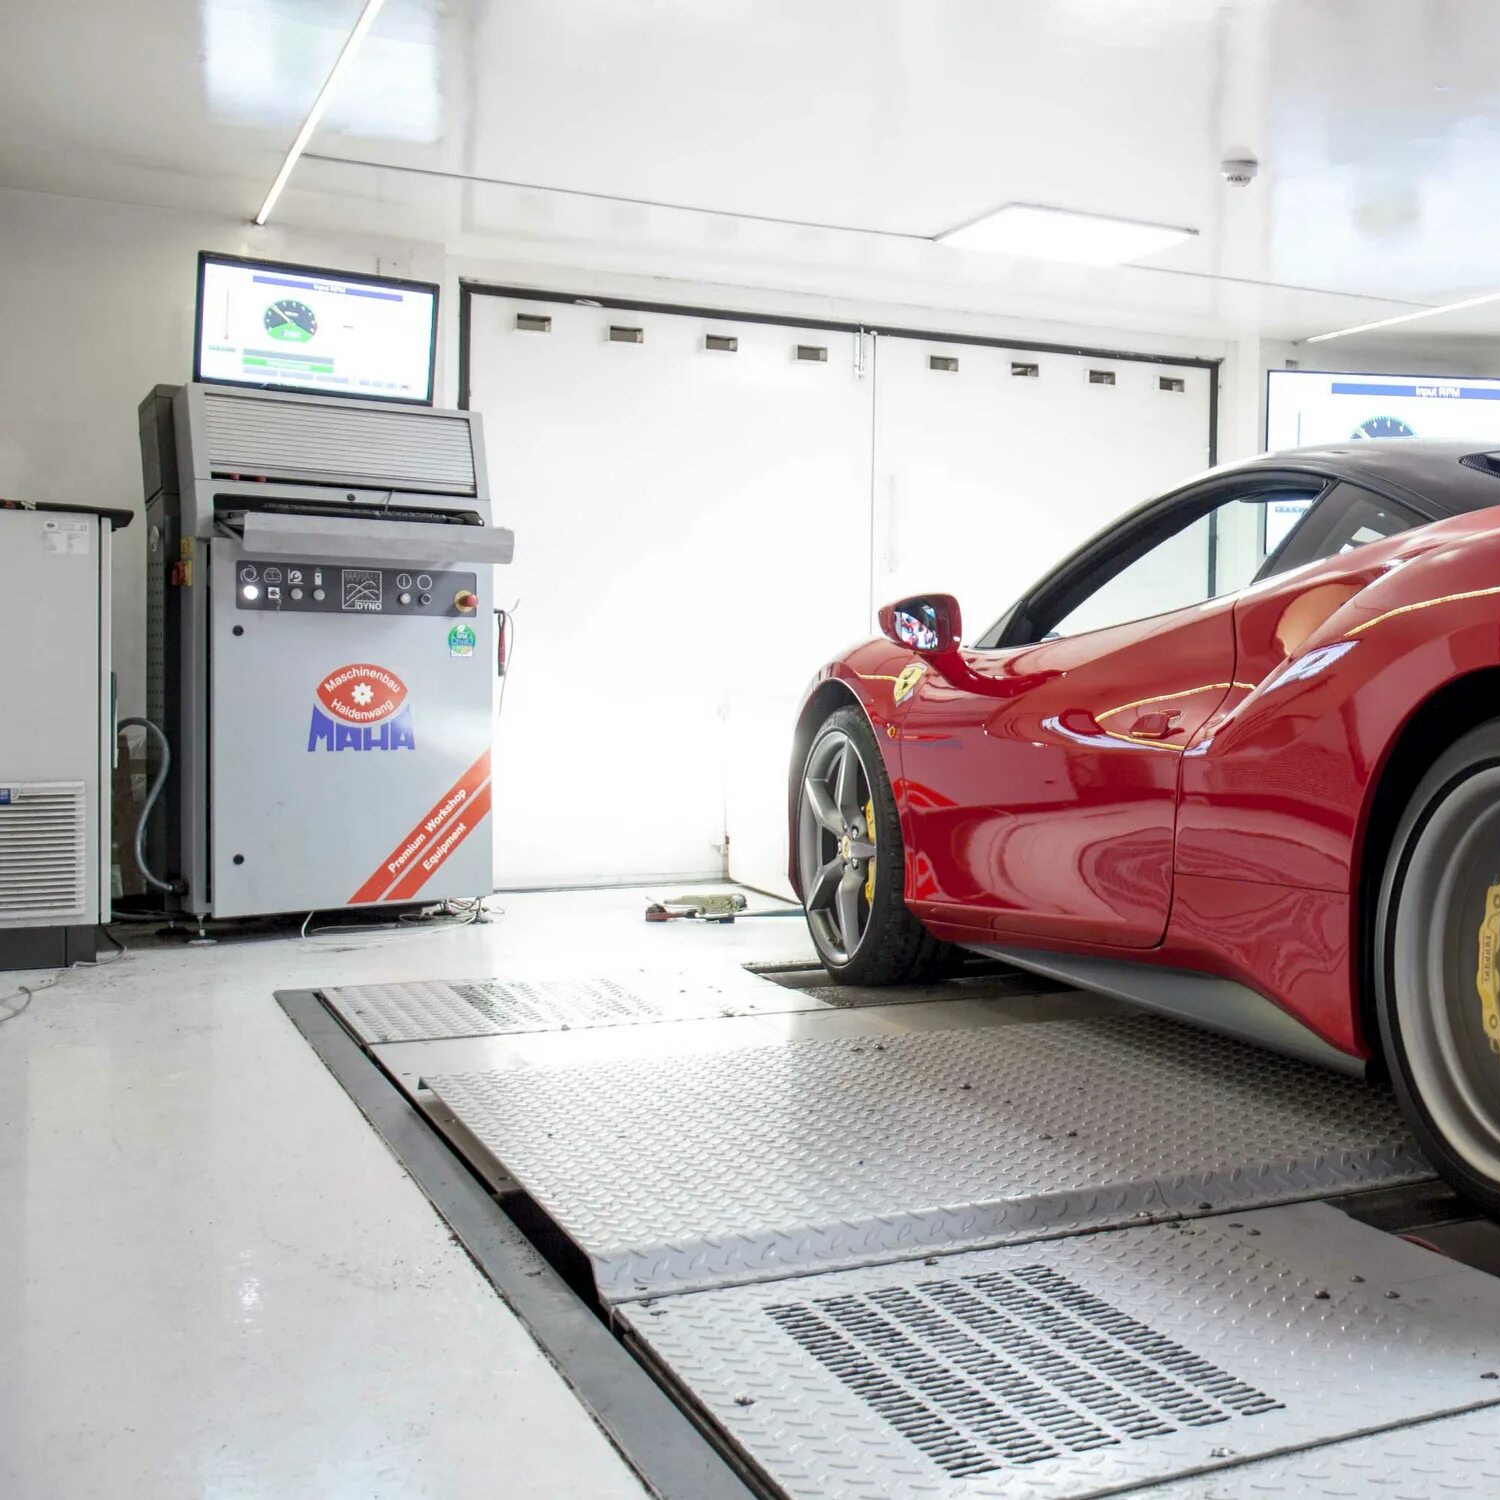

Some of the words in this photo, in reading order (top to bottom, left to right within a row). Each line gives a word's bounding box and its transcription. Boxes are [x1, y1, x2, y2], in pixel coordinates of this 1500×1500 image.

[1415, 385, 1438, 398] Input
[1439, 386, 1460, 399] RPM
[356, 601, 382, 611] DYNO
[324, 666, 400, 693] Maschinenbau
[331, 698, 394, 720] Haldenwang
[307, 703, 416, 752] MAHA
[387, 833, 426, 874] Premium
[424, 788, 467, 833] Workshop
[422, 822, 467, 872] Equipment
